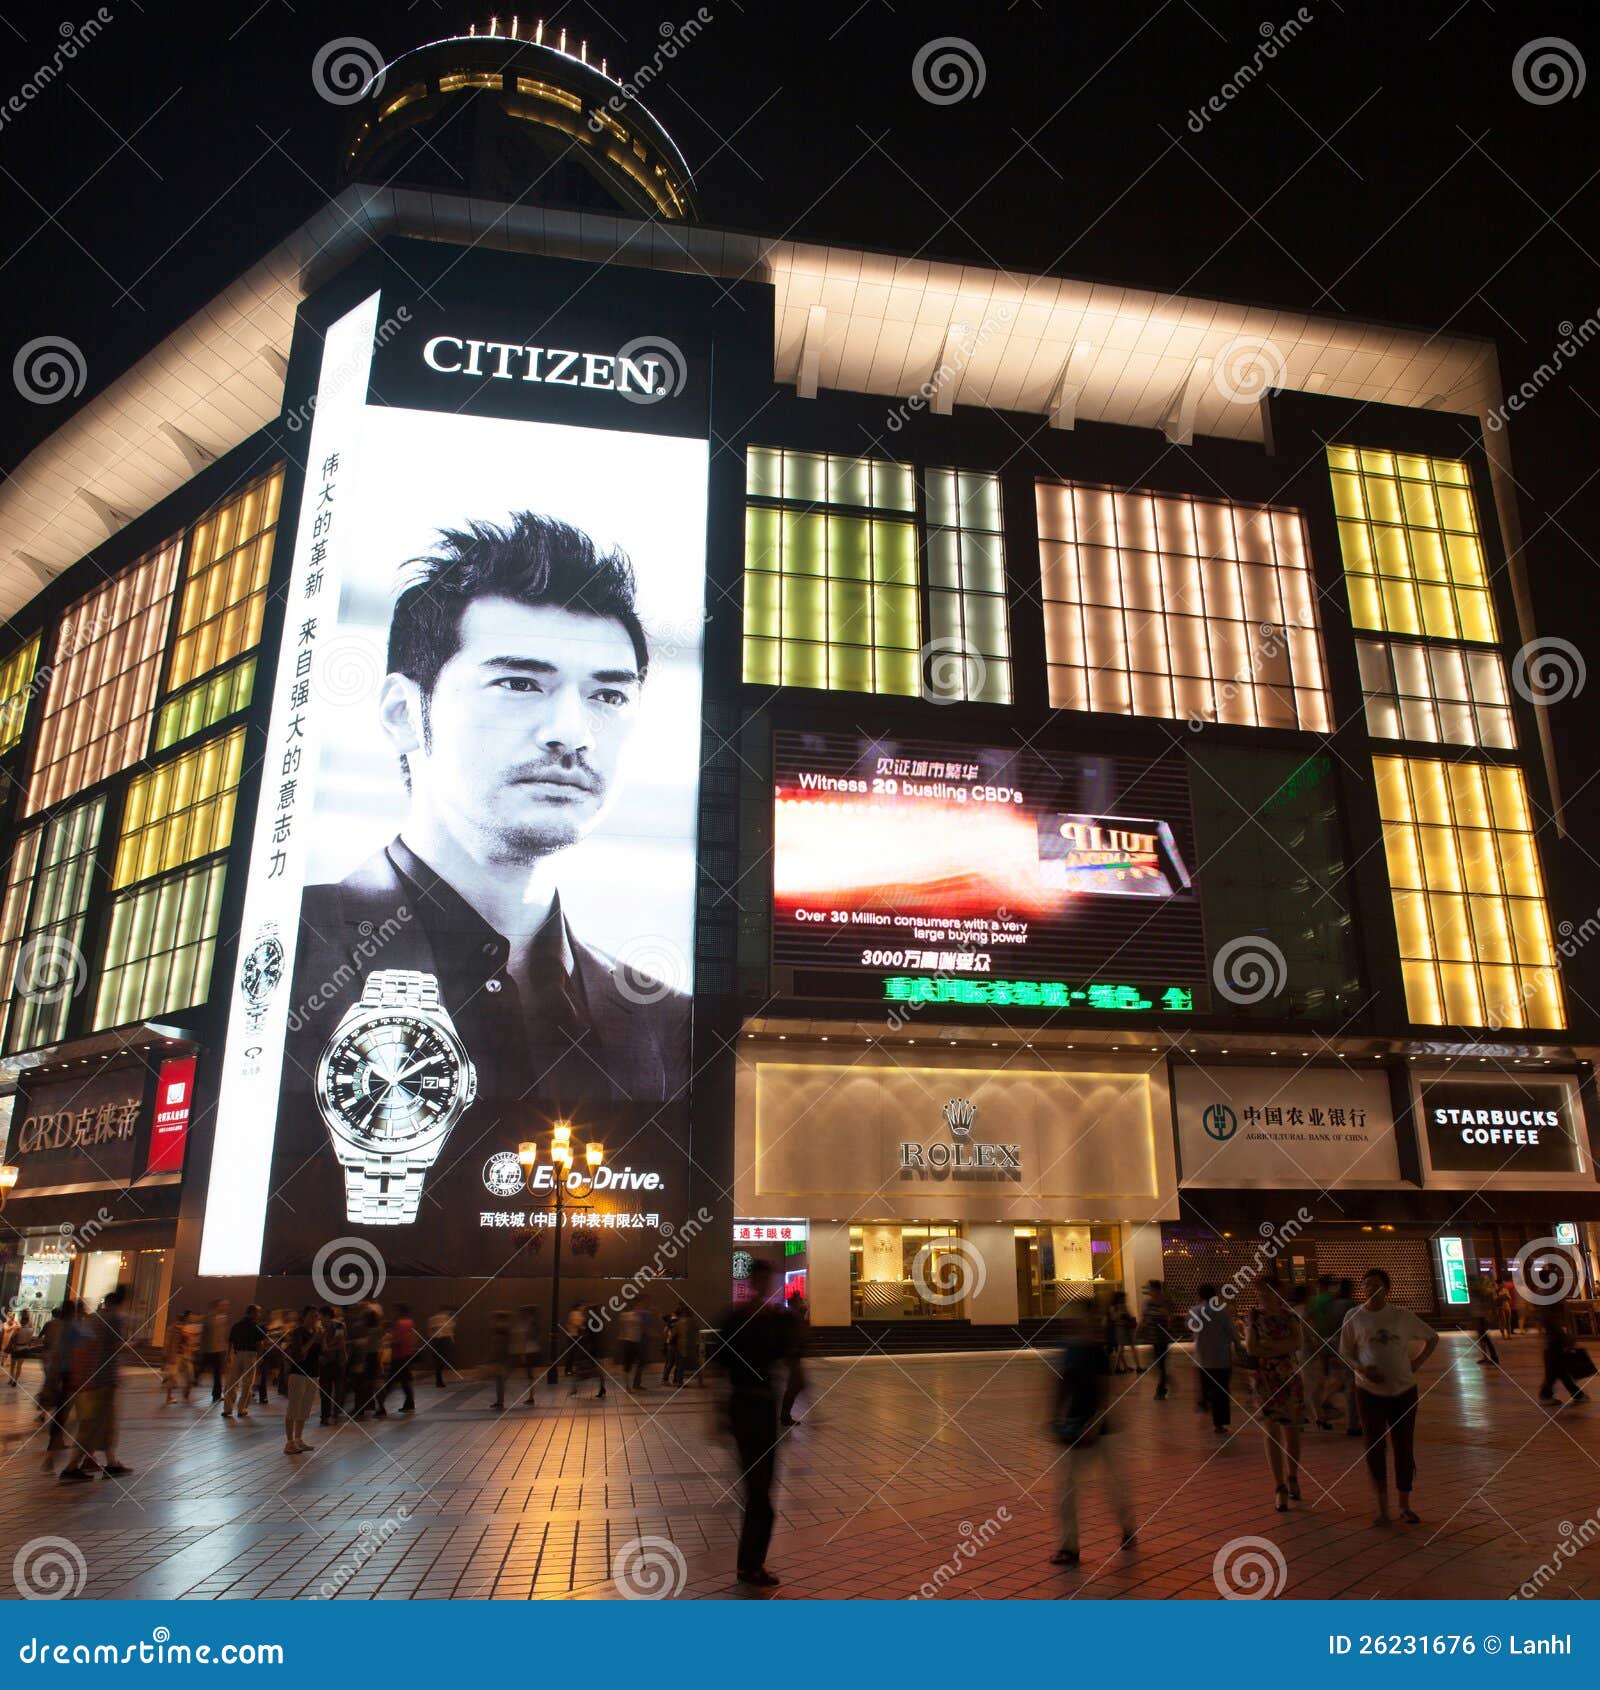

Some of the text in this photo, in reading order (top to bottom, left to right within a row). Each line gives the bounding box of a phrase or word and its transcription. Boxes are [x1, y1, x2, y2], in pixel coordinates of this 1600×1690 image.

[268, 453, 340, 879] 伟大的革新 来自强大的意志力
[799, 773, 1023, 804] Witness 20 bustling CBD's
[795, 909, 1027, 934] Over 30 Million consumers with a very
[914, 927, 1027, 944] large buying power
[1243, 1106, 1367, 1128] 中国农业银行
[1435, 1109, 1559, 1127] STARBUCKS
[1246, 1133, 1306, 1141] AGRICULTURAL
[1462, 1128, 1539, 1145] COFFEE
[900, 1143, 1023, 1167] ROLEX
